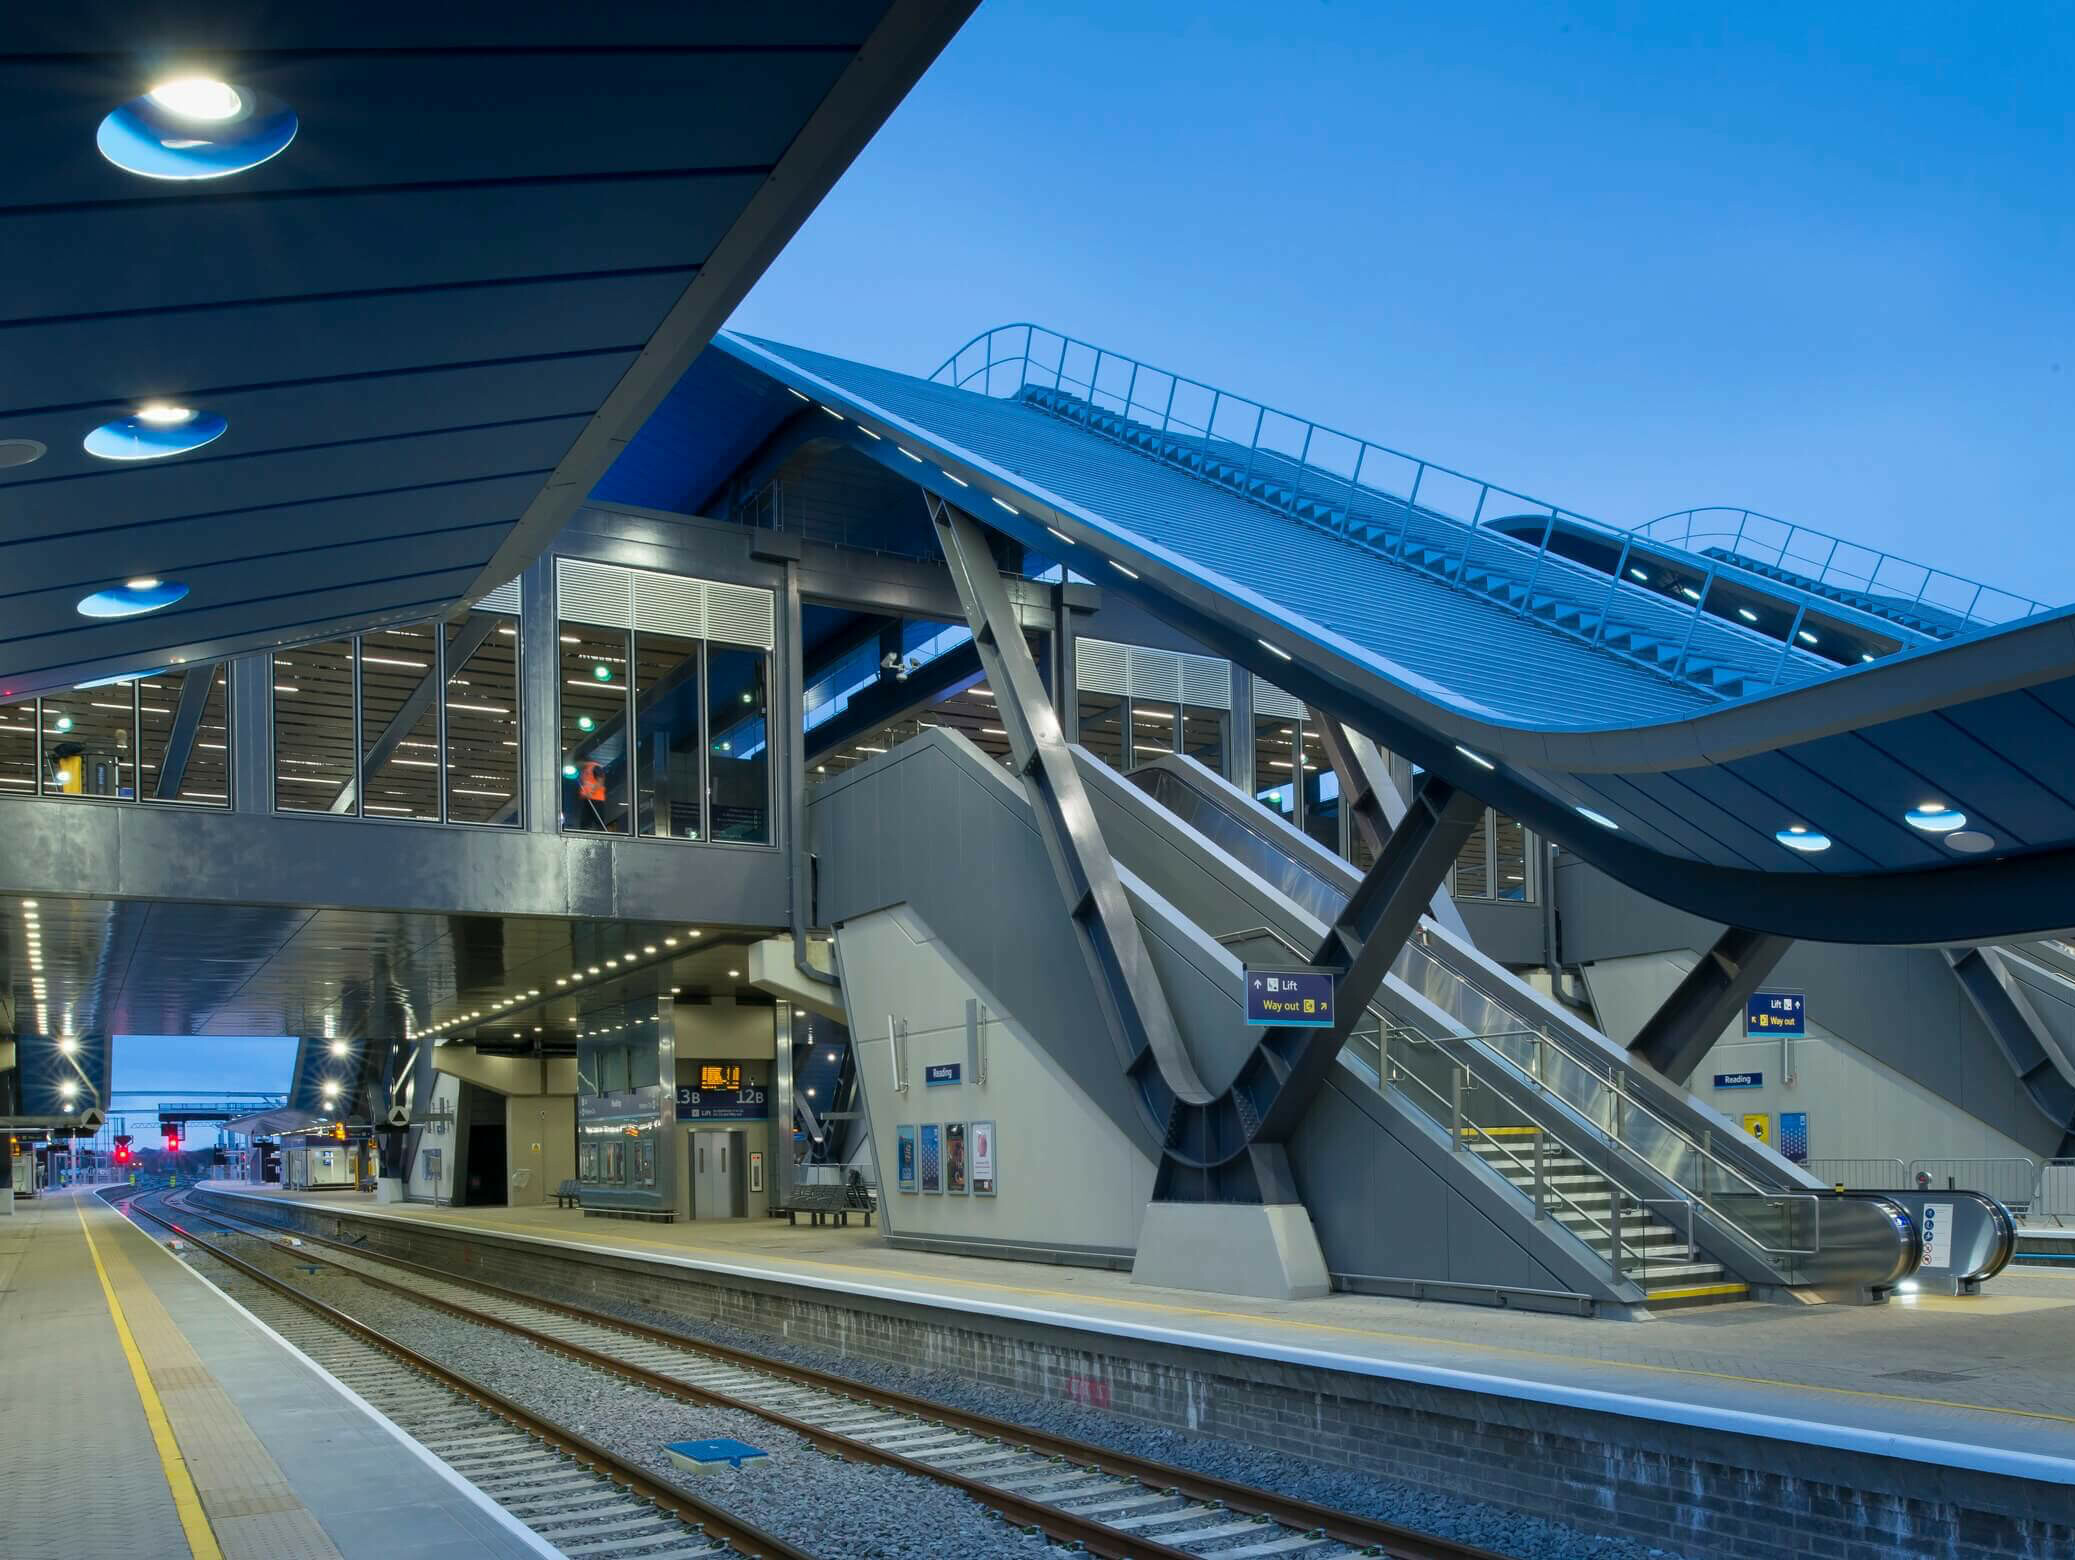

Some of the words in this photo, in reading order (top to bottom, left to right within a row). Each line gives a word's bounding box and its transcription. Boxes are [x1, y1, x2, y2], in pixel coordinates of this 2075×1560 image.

[1282, 980, 1298, 991] Lift
[1263, 999, 1282, 1013] Way
[1284, 1002, 1300, 1011] out
[1770, 999, 1782, 1009] Lift
[1770, 1016, 1784, 1027] Way
[1784, 1017, 1795, 1026] out
[932, 1067, 953, 1079] Reading
[1724, 1074, 1752, 1085] Reading
[736, 1088, 764, 1104] 12B
